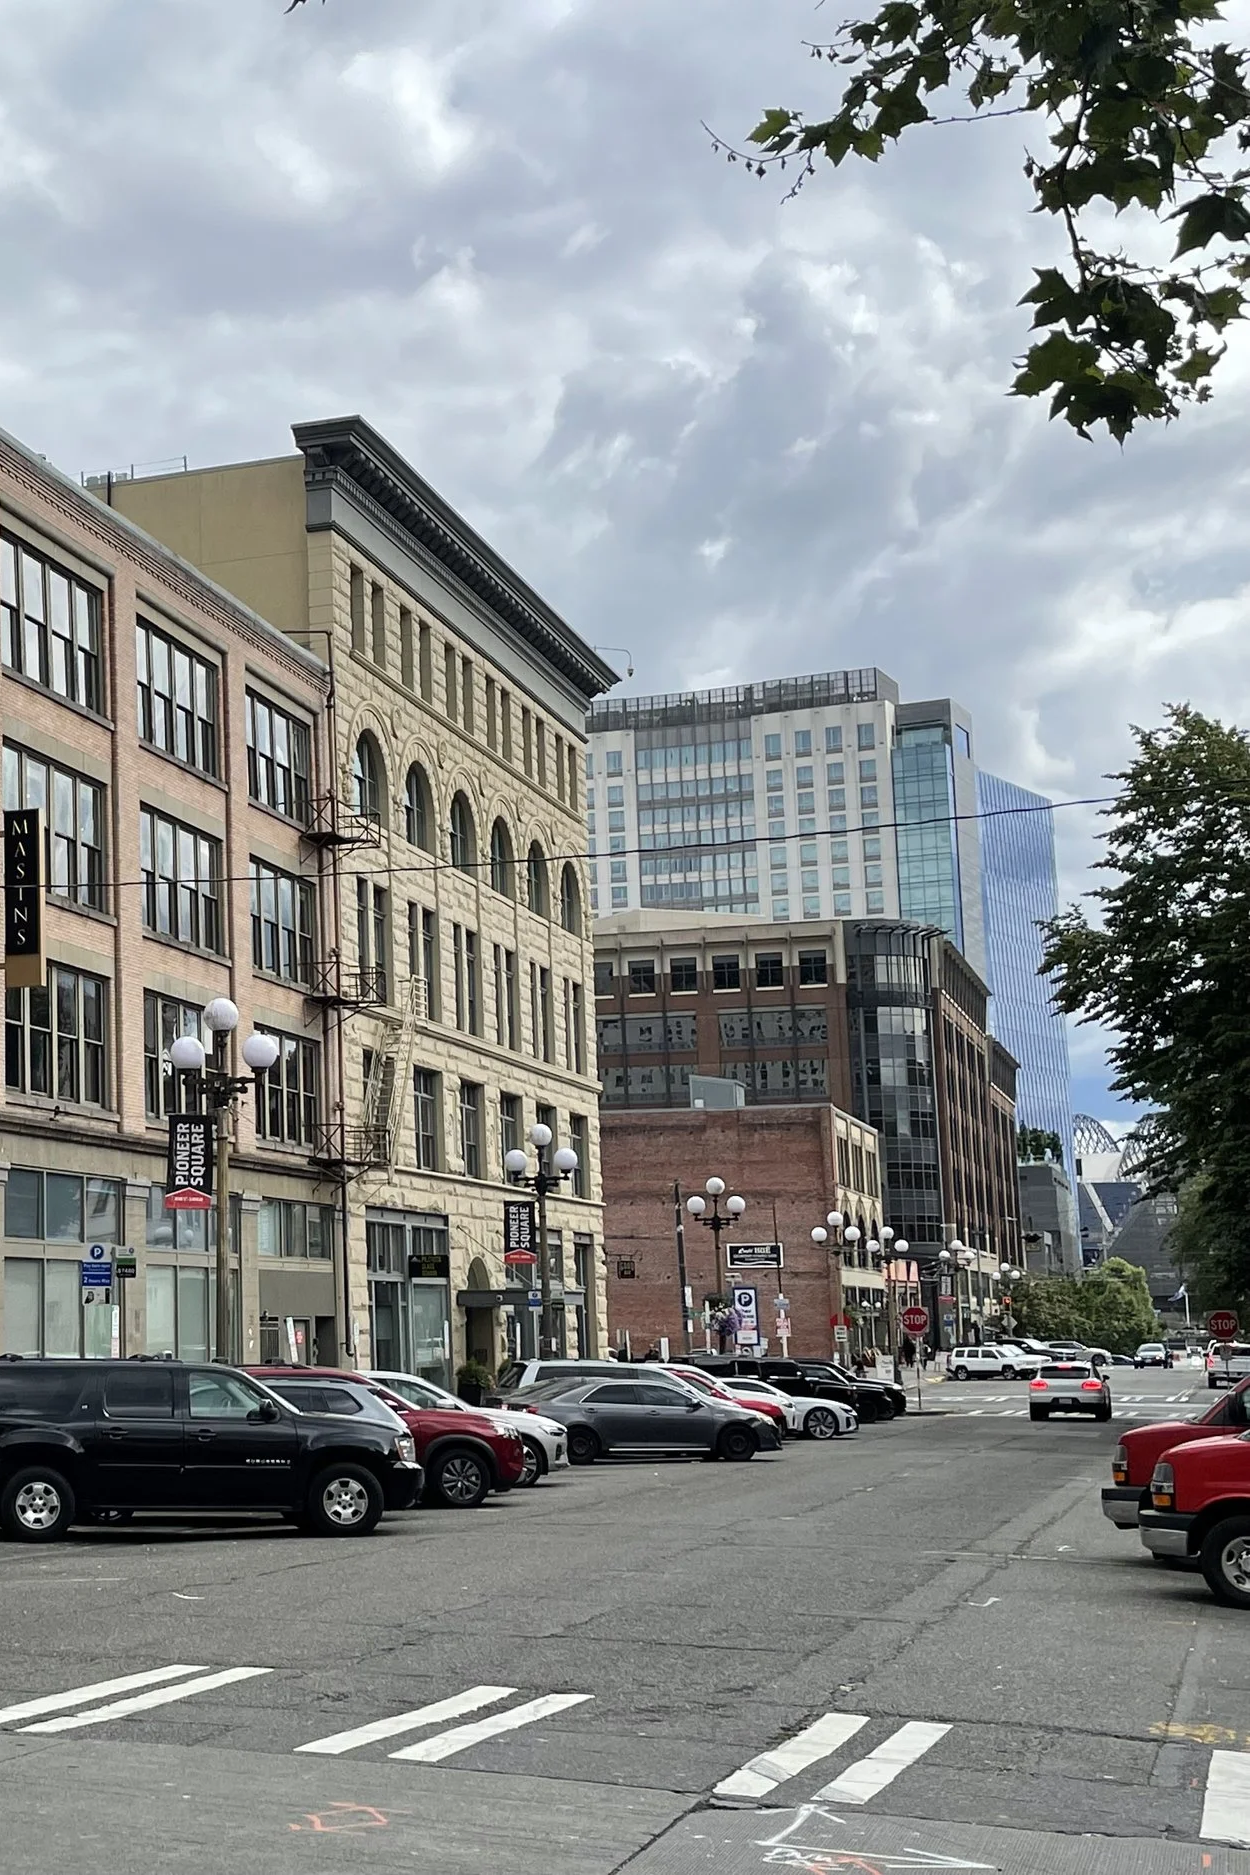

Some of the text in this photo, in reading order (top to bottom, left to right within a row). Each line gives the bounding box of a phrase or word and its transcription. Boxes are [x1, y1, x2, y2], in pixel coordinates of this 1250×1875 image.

[175, 1122, 190, 1186] PIONEER
[190, 1123, 206, 1187] SQUARE
[509, 1205, 520, 1248] PIONEER
[519, 1206, 531, 1249] SQUARE
[83, 1276, 88, 1284] 2
[903, 1315, 927, 1325] STOP
[1210, 1319, 1237, 1330] STOP
